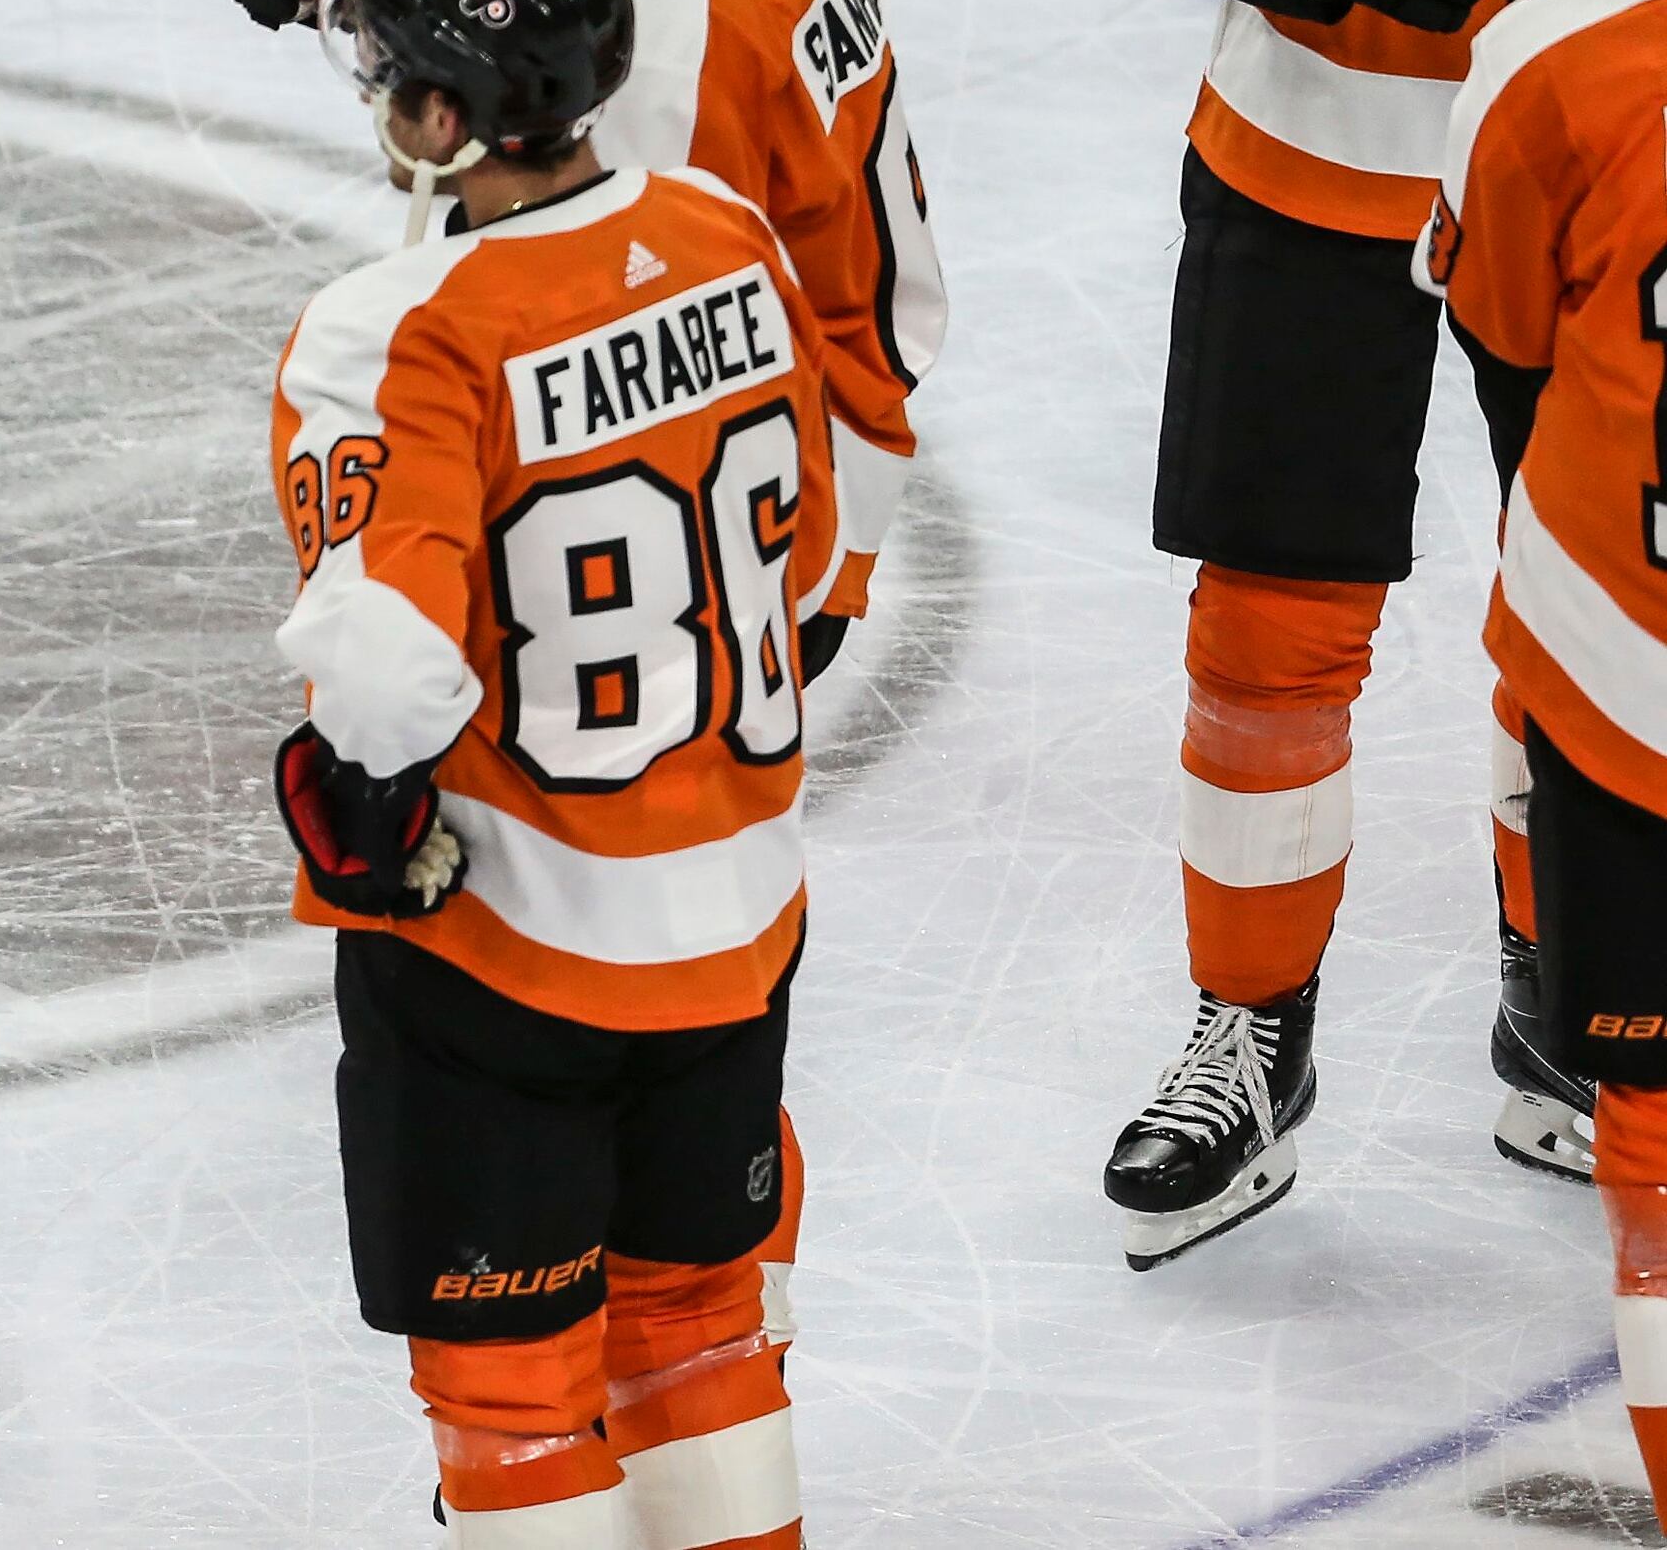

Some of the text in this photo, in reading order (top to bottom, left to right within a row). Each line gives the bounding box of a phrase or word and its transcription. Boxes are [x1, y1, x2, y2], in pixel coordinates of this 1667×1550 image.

[534, 278, 777, 446] FARABEE
[285, 434, 389, 579] 86
[488, 396, 803, 794] 86
[432, 1243, 603, 1302] BAUER
